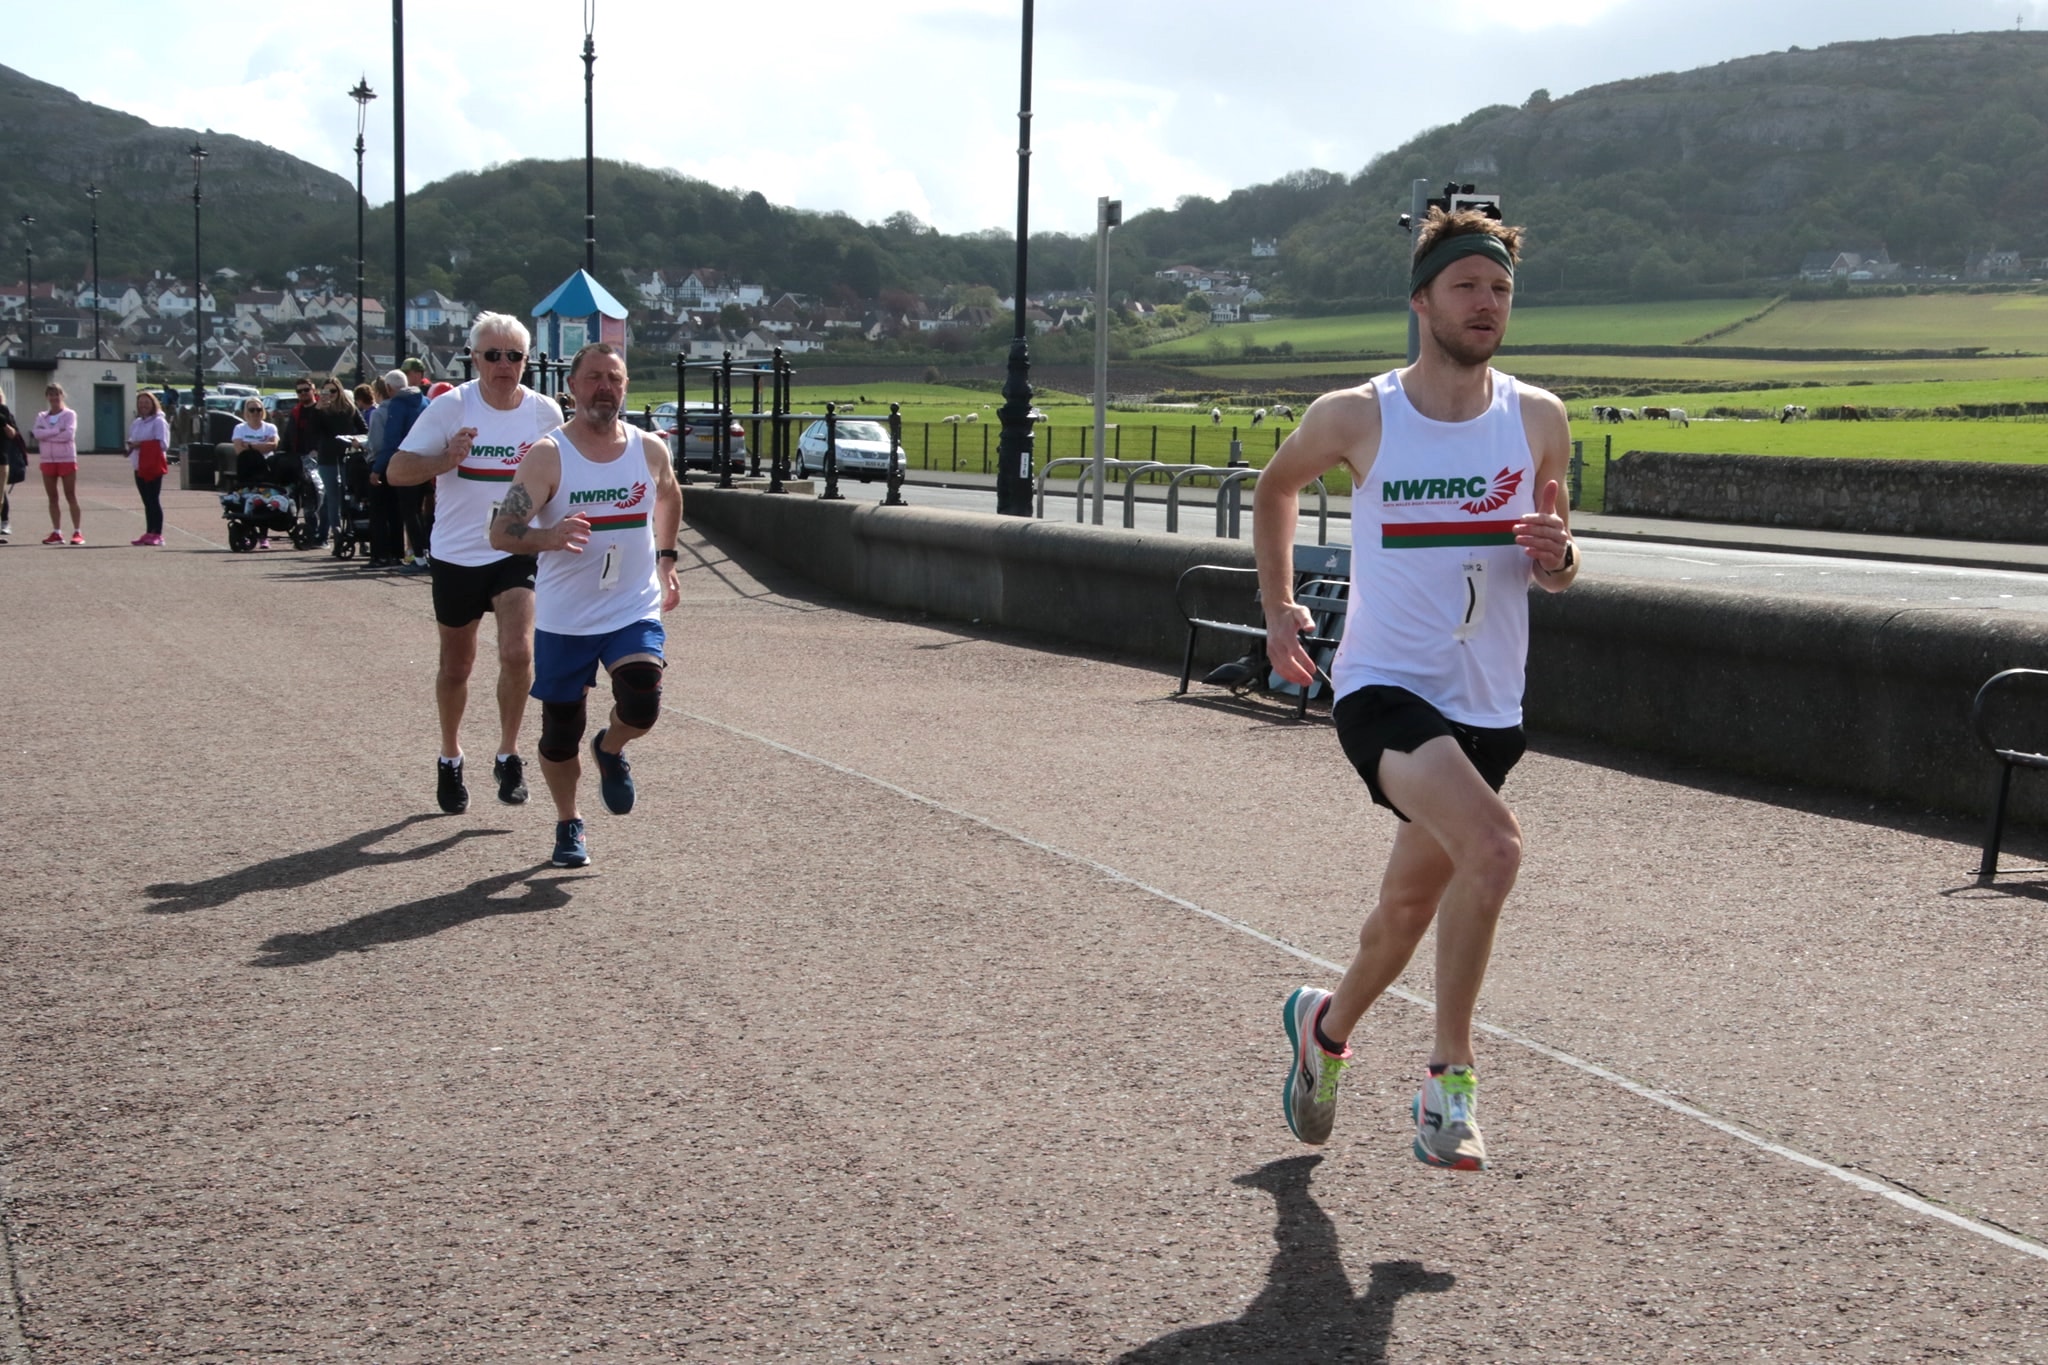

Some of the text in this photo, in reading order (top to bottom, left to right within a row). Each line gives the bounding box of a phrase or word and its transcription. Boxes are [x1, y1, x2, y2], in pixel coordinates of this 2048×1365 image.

[471, 445, 515, 458] WRRC
[569, 487, 628, 505] NWRRC
[1382, 475, 1487, 502] NWRRC
